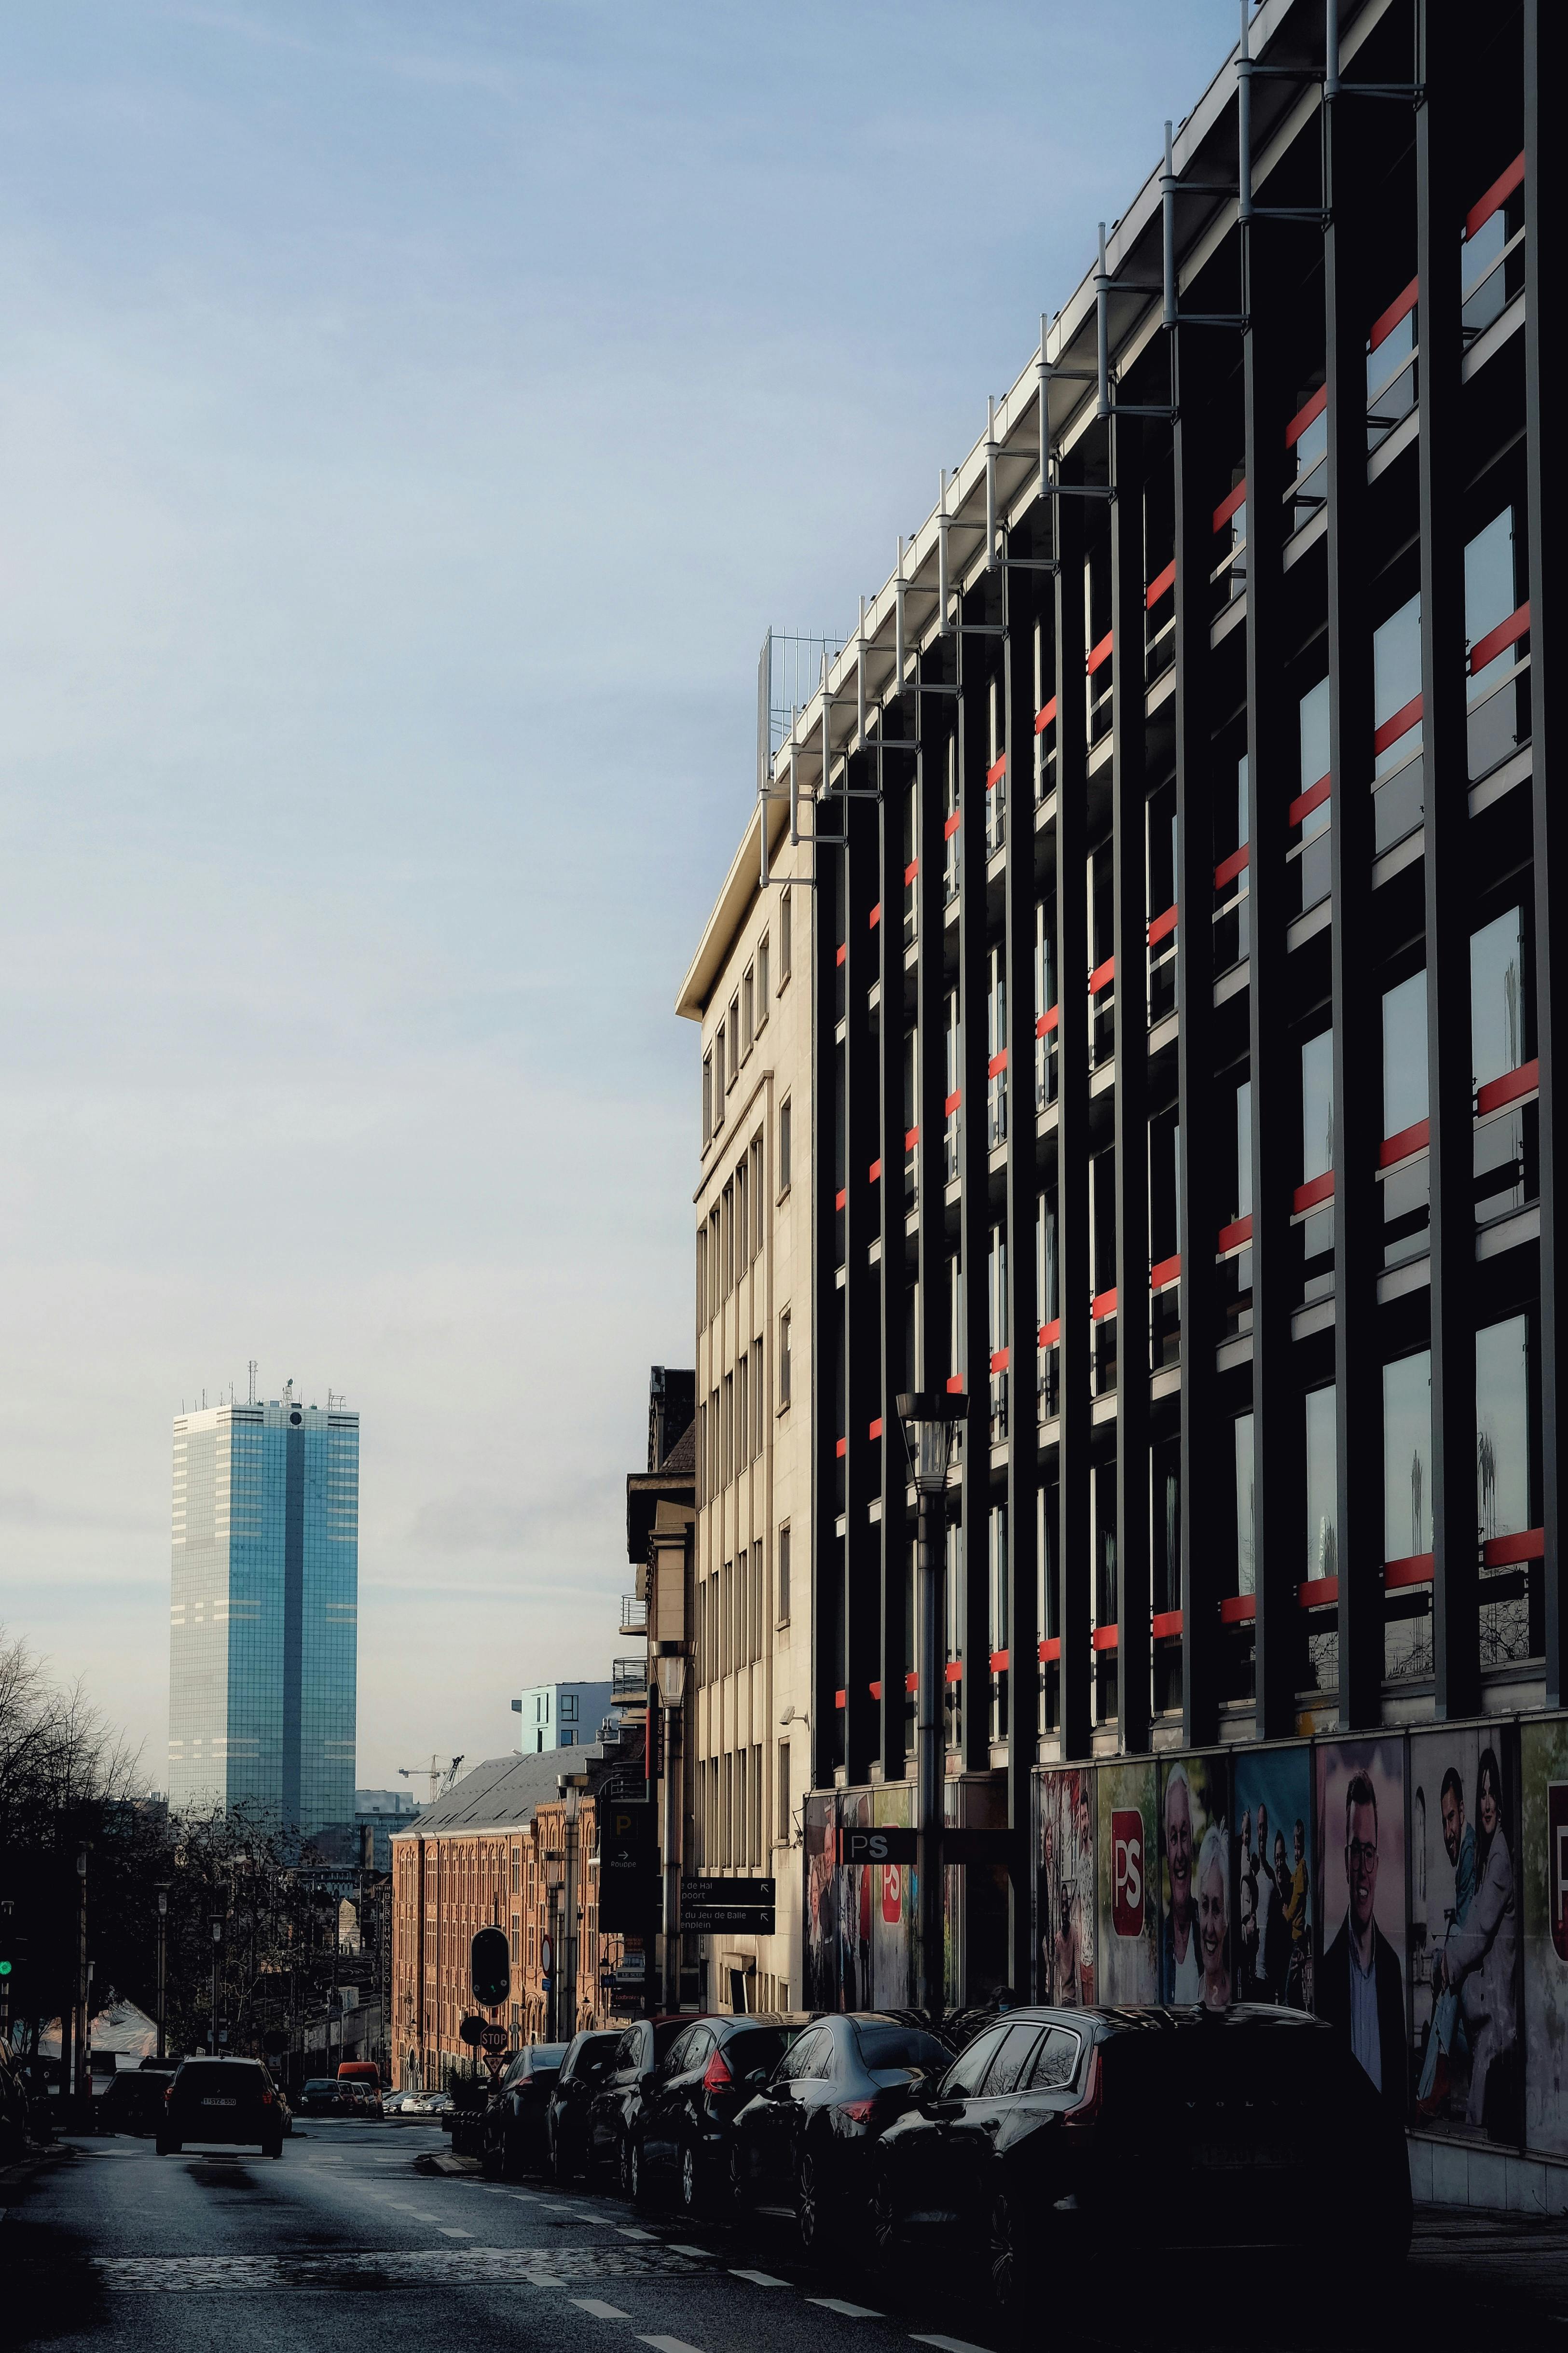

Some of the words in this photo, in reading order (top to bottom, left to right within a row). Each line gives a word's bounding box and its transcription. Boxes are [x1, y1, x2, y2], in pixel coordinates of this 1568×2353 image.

[616, 1815, 632, 1835] P
[851, 1835, 888, 1858] PS
[884, 1865, 900, 1901] PS
[1115, 1839, 1142, 1909] PS
[482, 2034, 507, 2045] STOP
